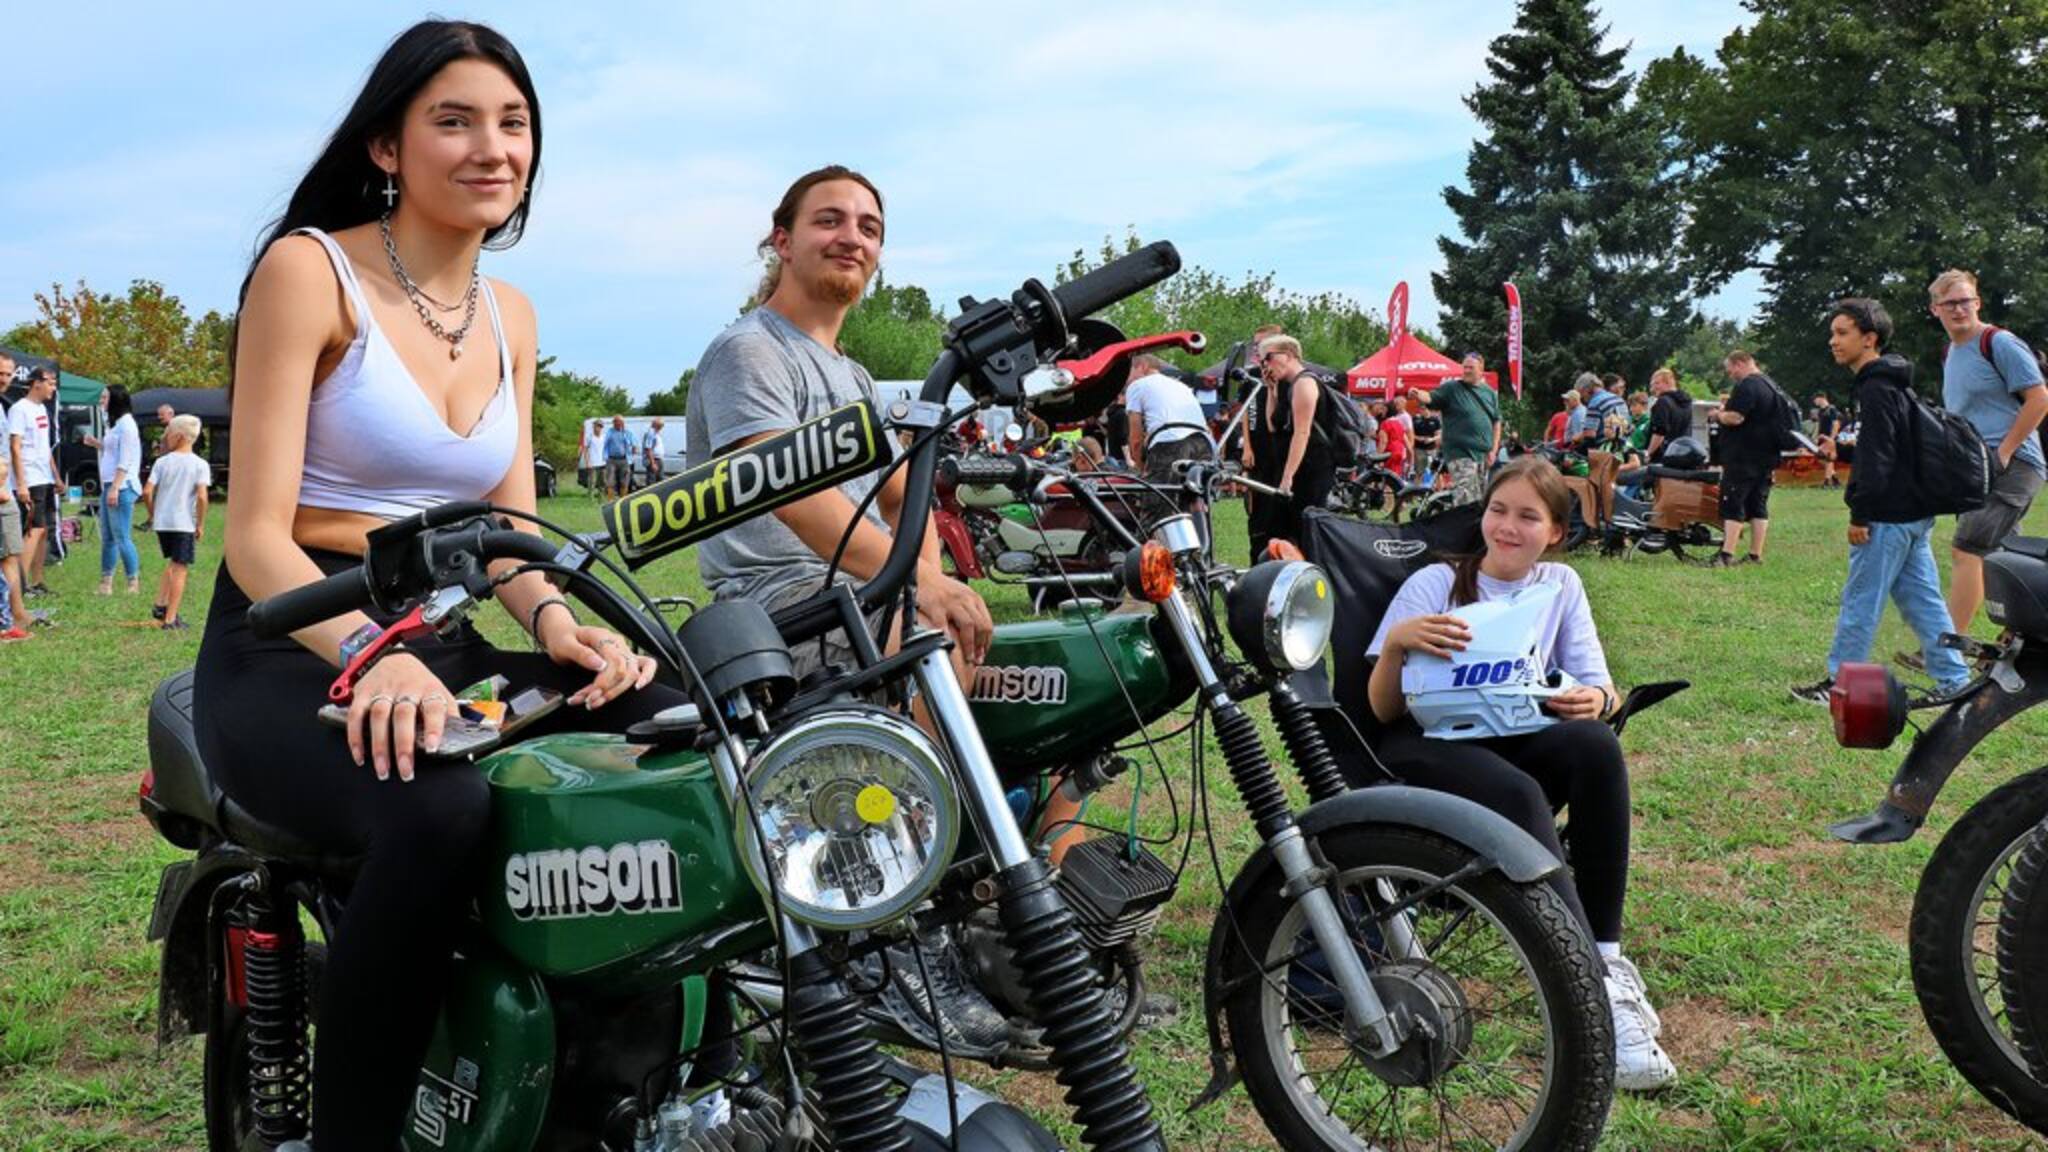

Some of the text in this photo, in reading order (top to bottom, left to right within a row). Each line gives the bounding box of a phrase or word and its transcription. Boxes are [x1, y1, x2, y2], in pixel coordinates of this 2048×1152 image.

[1507, 305, 1520, 362] MOTUL
[1355, 377, 1404, 389] MOTL
[629, 417, 860, 547] DorfDullis
[971, 665, 1067, 704] mson
[1452, 658, 1535, 687] 100%
